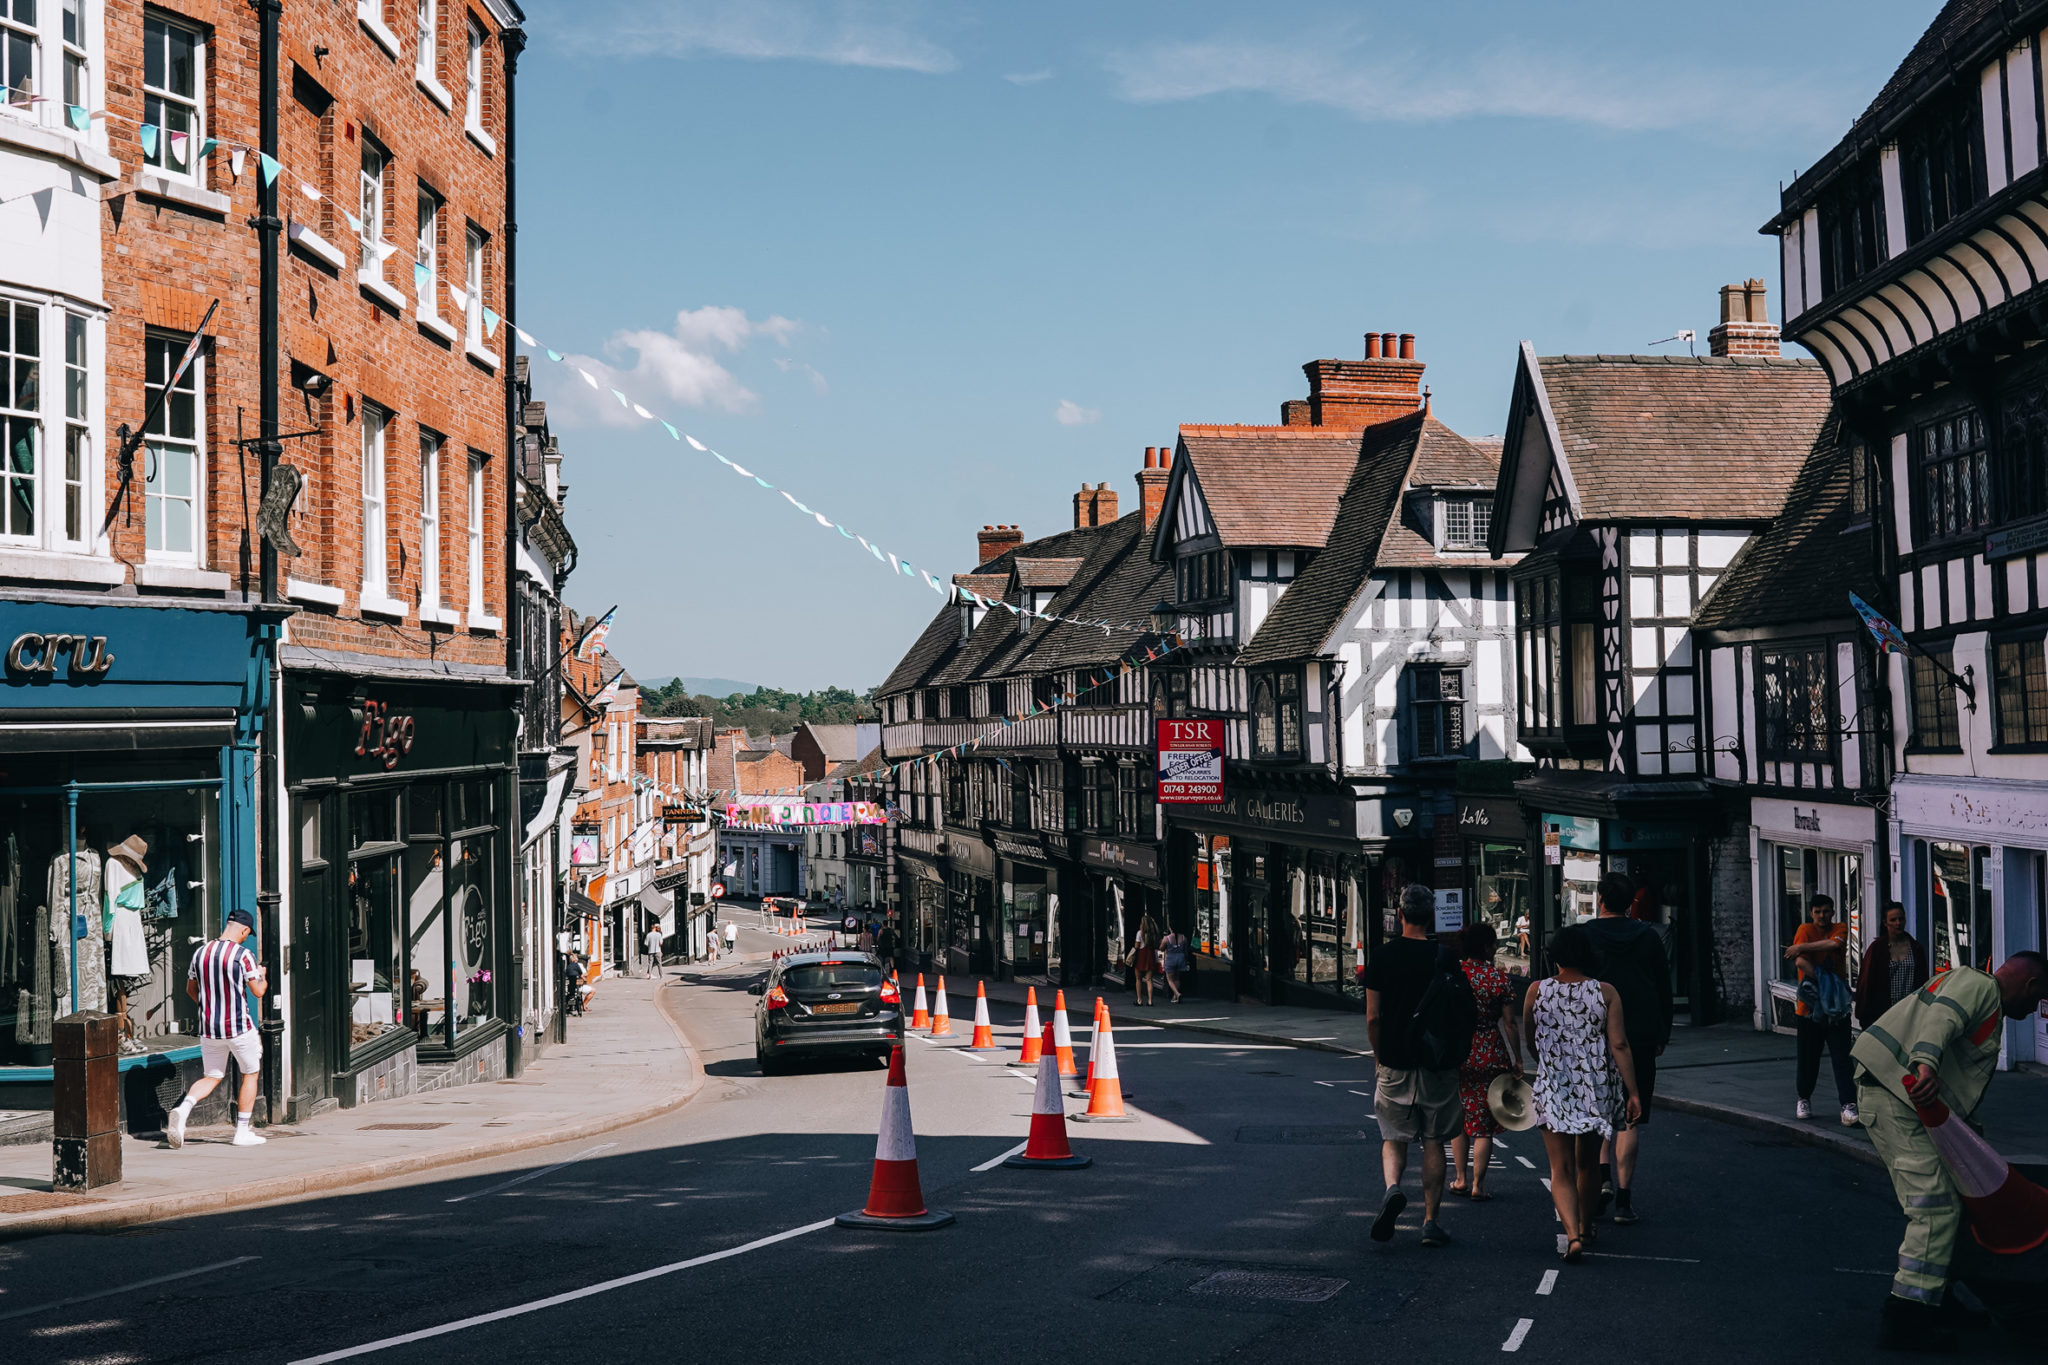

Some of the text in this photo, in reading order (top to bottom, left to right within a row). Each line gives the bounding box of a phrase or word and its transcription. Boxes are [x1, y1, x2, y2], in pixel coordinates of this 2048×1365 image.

[9, 633, 115, 672] cru
[355, 700, 415, 769] Figo
[1169, 722, 1211, 740] TSR
[1166, 762, 1190, 777] UNDER
[1190, 752, 1213, 767] OFFER
[1163, 785, 1217, 794] 01743 243900
[1247, 799, 1305, 823] GALLERIES
